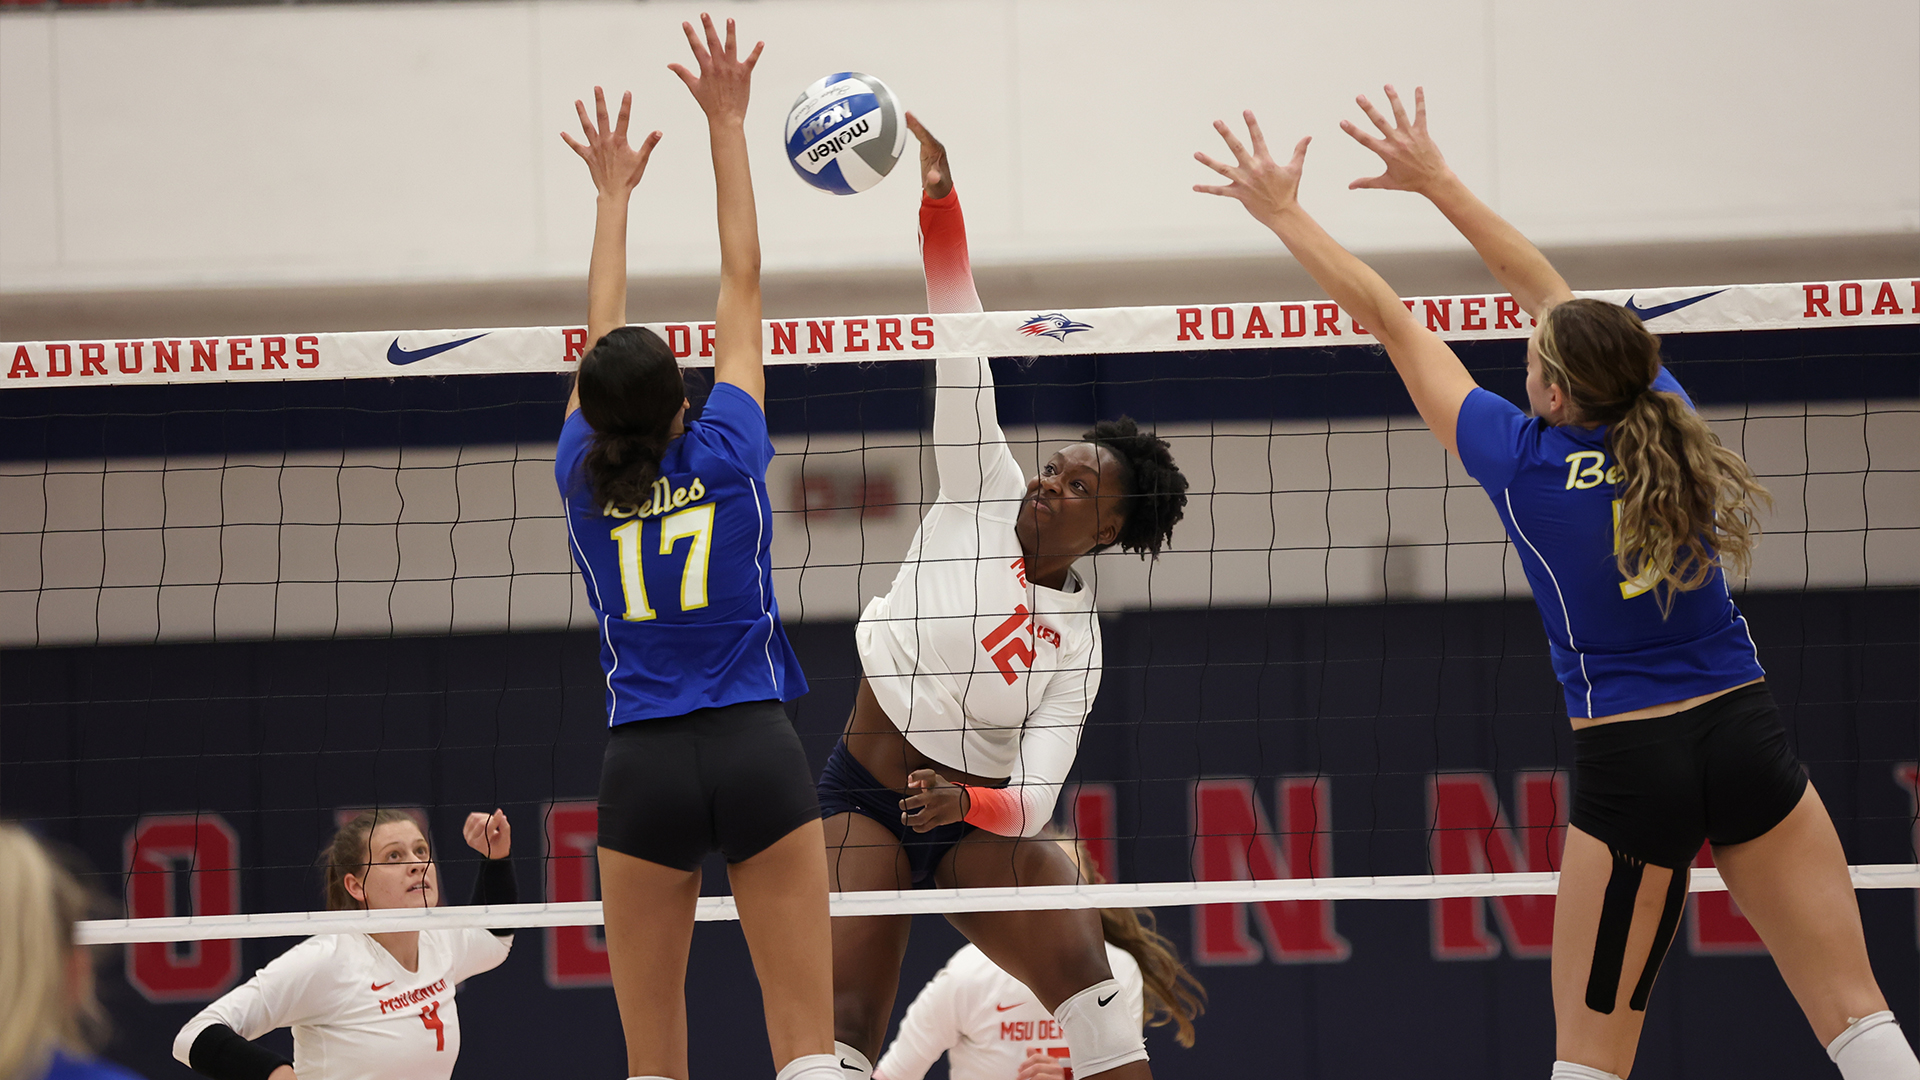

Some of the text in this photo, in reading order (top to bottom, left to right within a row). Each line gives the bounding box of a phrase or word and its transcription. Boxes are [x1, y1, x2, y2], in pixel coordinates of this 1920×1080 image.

[801, 99, 853, 142] NCAA
[807, 119, 869, 163] molten
[562, 317, 935, 362] RDRNNERS
[1176, 296, 1537, 341] ROADRNER
[7, 335, 320, 378] ADRUNNERS
[610, 502, 716, 622] 17
[980, 603, 1038, 686] 12
[418, 1000, 445, 1052] 4
[1000, 1021, 1034, 1041] MSU
